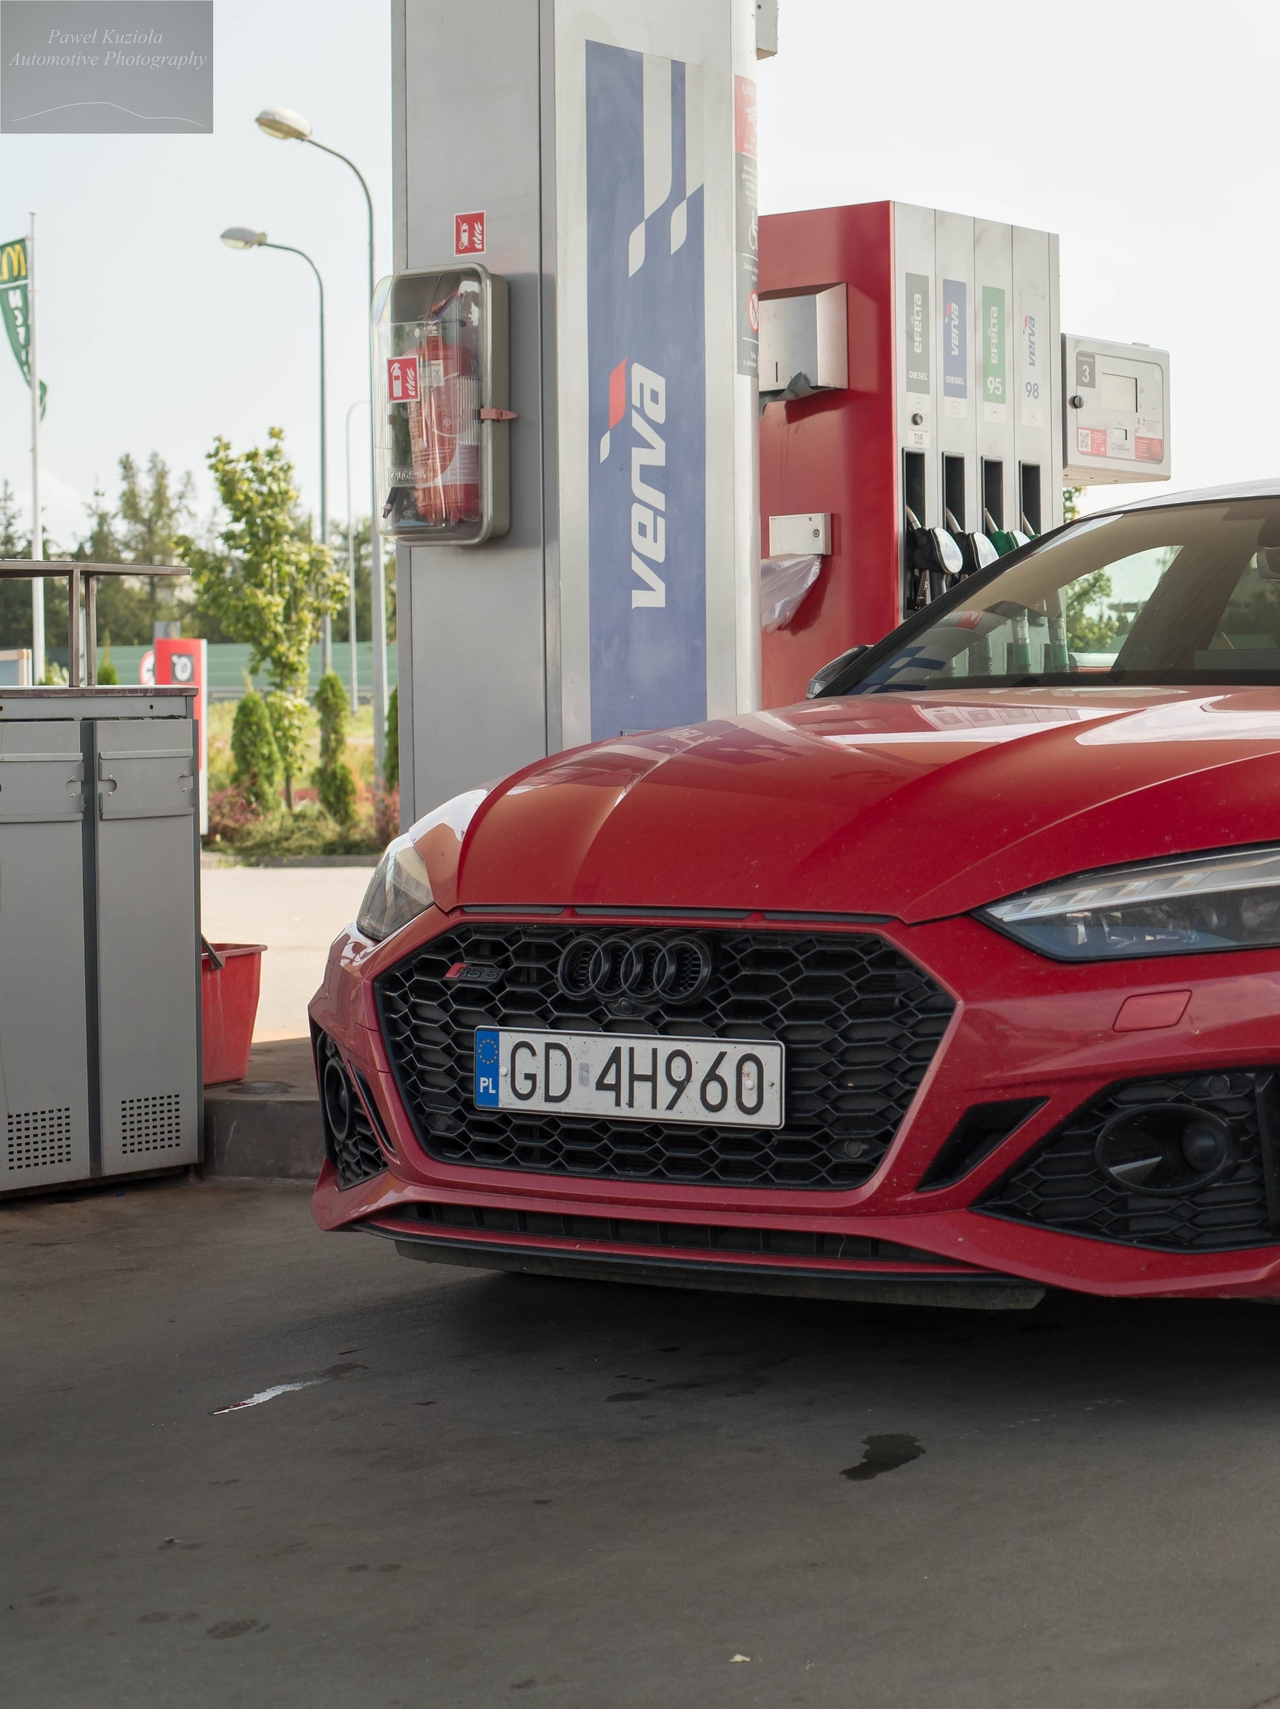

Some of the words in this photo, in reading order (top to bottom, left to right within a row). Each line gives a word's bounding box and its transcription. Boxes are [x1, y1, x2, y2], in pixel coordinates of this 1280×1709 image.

[951, 302, 959, 356] verva
[908, 370, 928, 381] DIESEL
[946, 375, 965, 385] DIESEL
[1082, 364, 1090, 383] 3
[987, 376, 1002, 395] 95
[1025, 381, 1040, 399] 98
[913, 433, 924, 441] TIR
[631, 361, 666, 609] verva
[480, 1077, 496, 1093] PL
[510, 1040, 572, 1103] GD
[595, 1045, 764, 1115] 4H960
